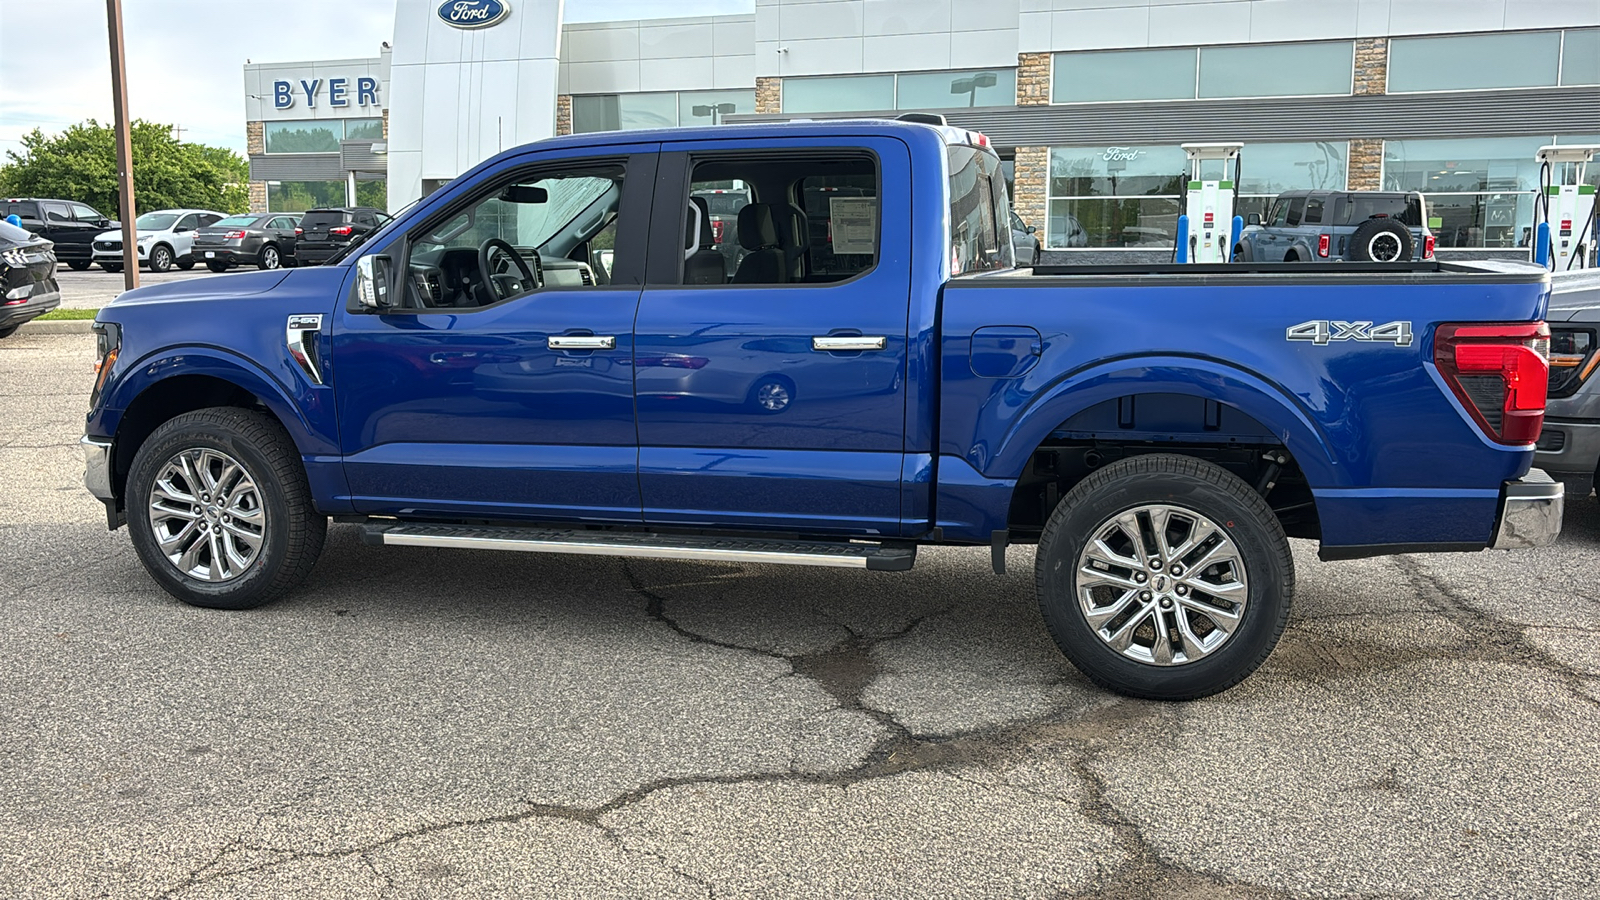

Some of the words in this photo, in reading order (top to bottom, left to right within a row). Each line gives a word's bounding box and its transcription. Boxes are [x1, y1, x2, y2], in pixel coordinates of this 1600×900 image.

[450, 1, 490, 20] Ford
[273, 77, 380, 108] BYER
[1102, 146, 1139, 161] Ford
